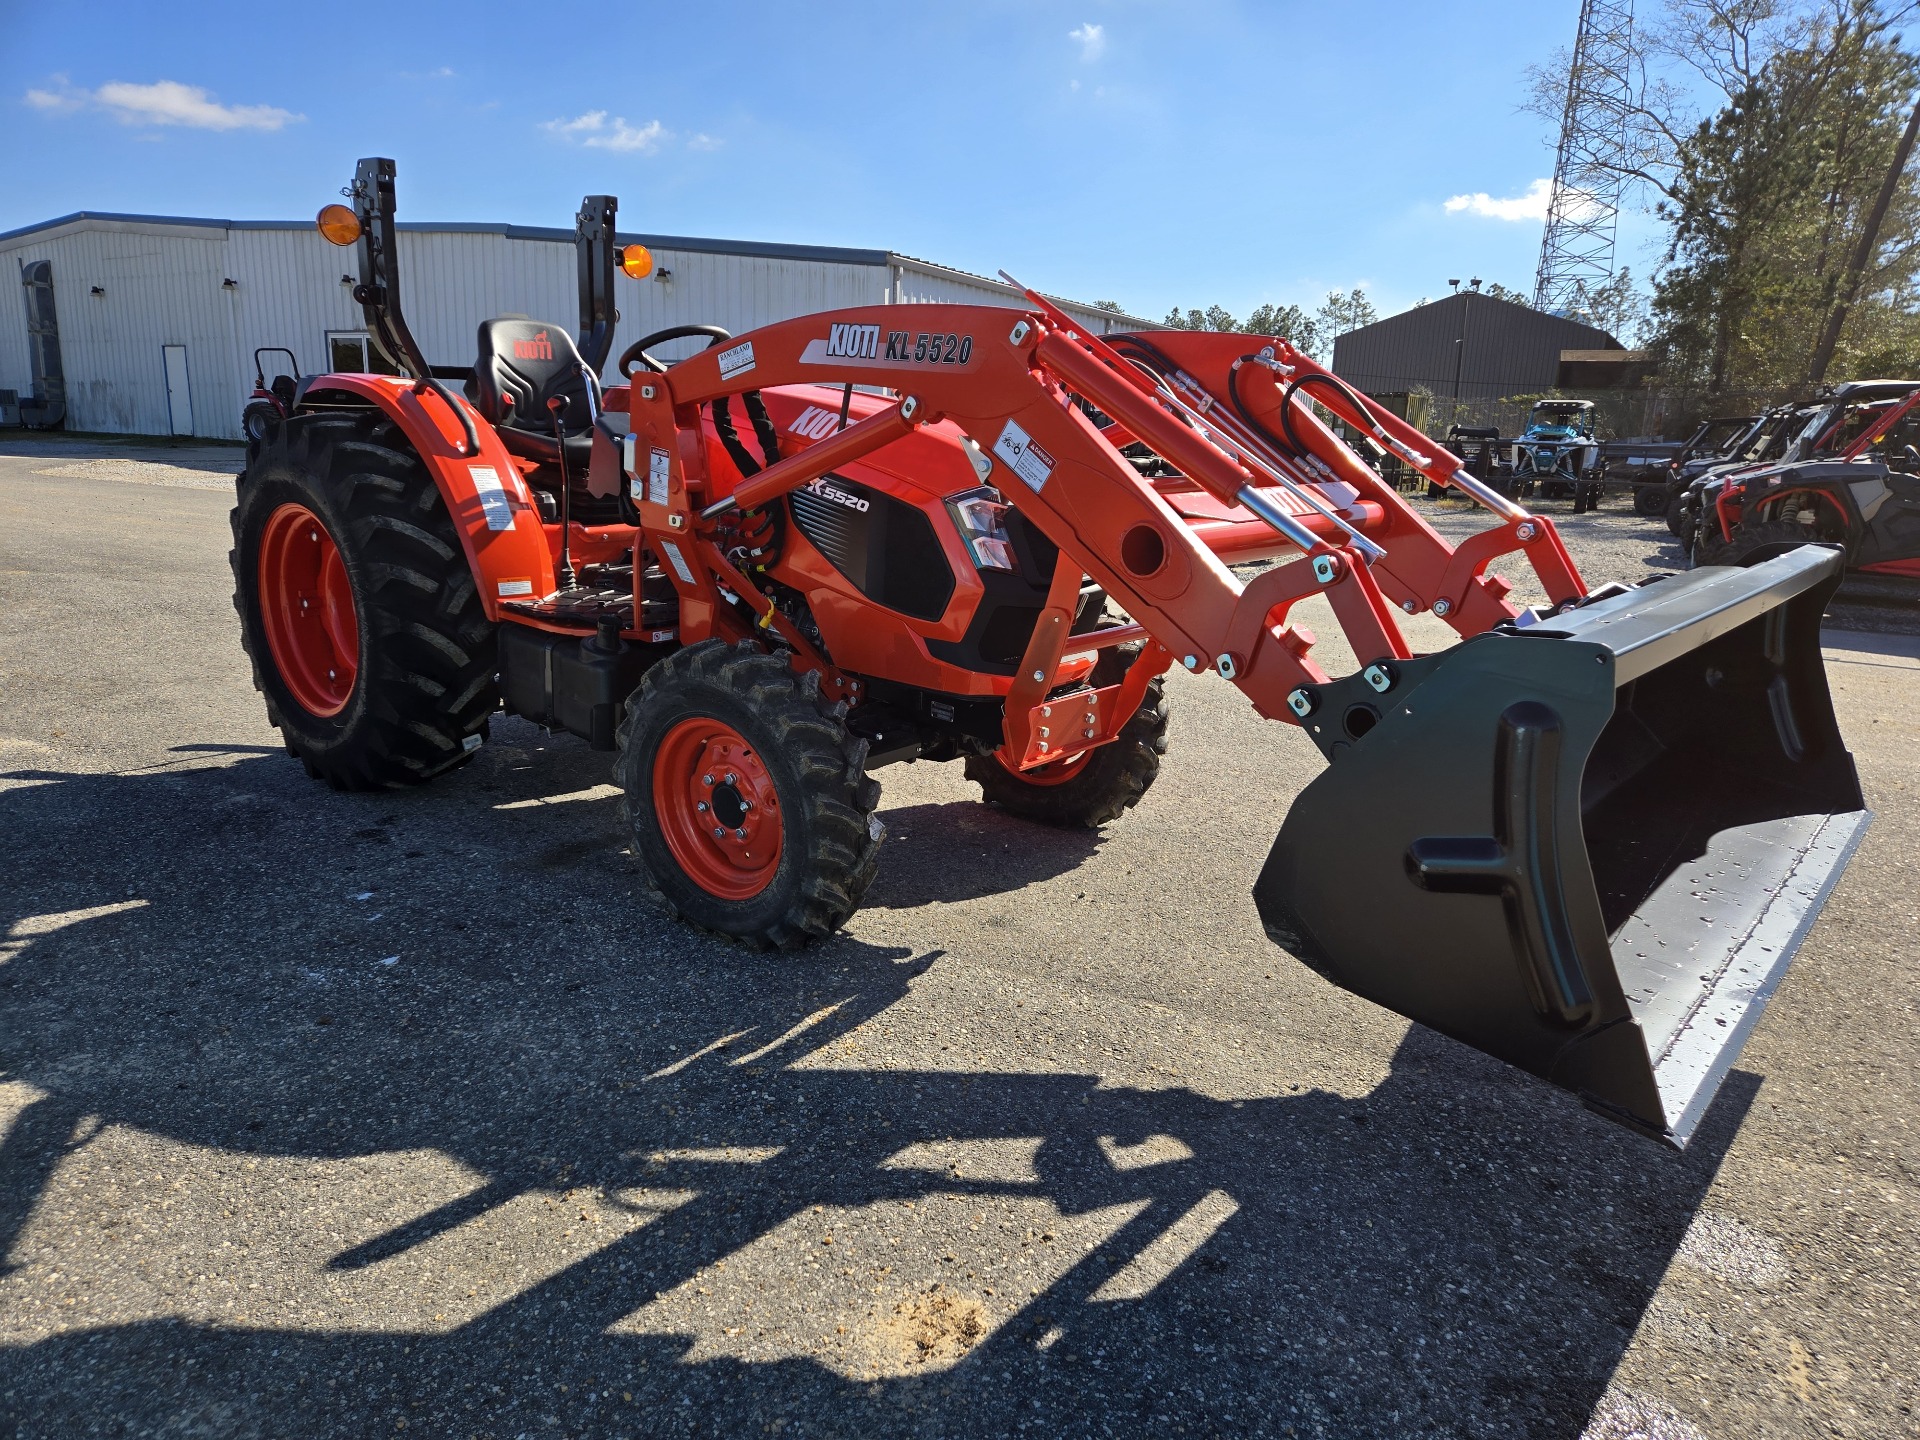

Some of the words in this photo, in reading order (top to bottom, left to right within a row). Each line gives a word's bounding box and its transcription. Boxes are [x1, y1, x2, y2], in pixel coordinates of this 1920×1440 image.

[513, 339, 552, 360] KIOTI
[720, 343, 750, 361] RANCHLAND
[826, 323, 881, 360] KIOTI
[787, 405, 860, 440] KIO
[1034, 448, 1053, 466] DANGER
[802, 477, 870, 513] K5520
